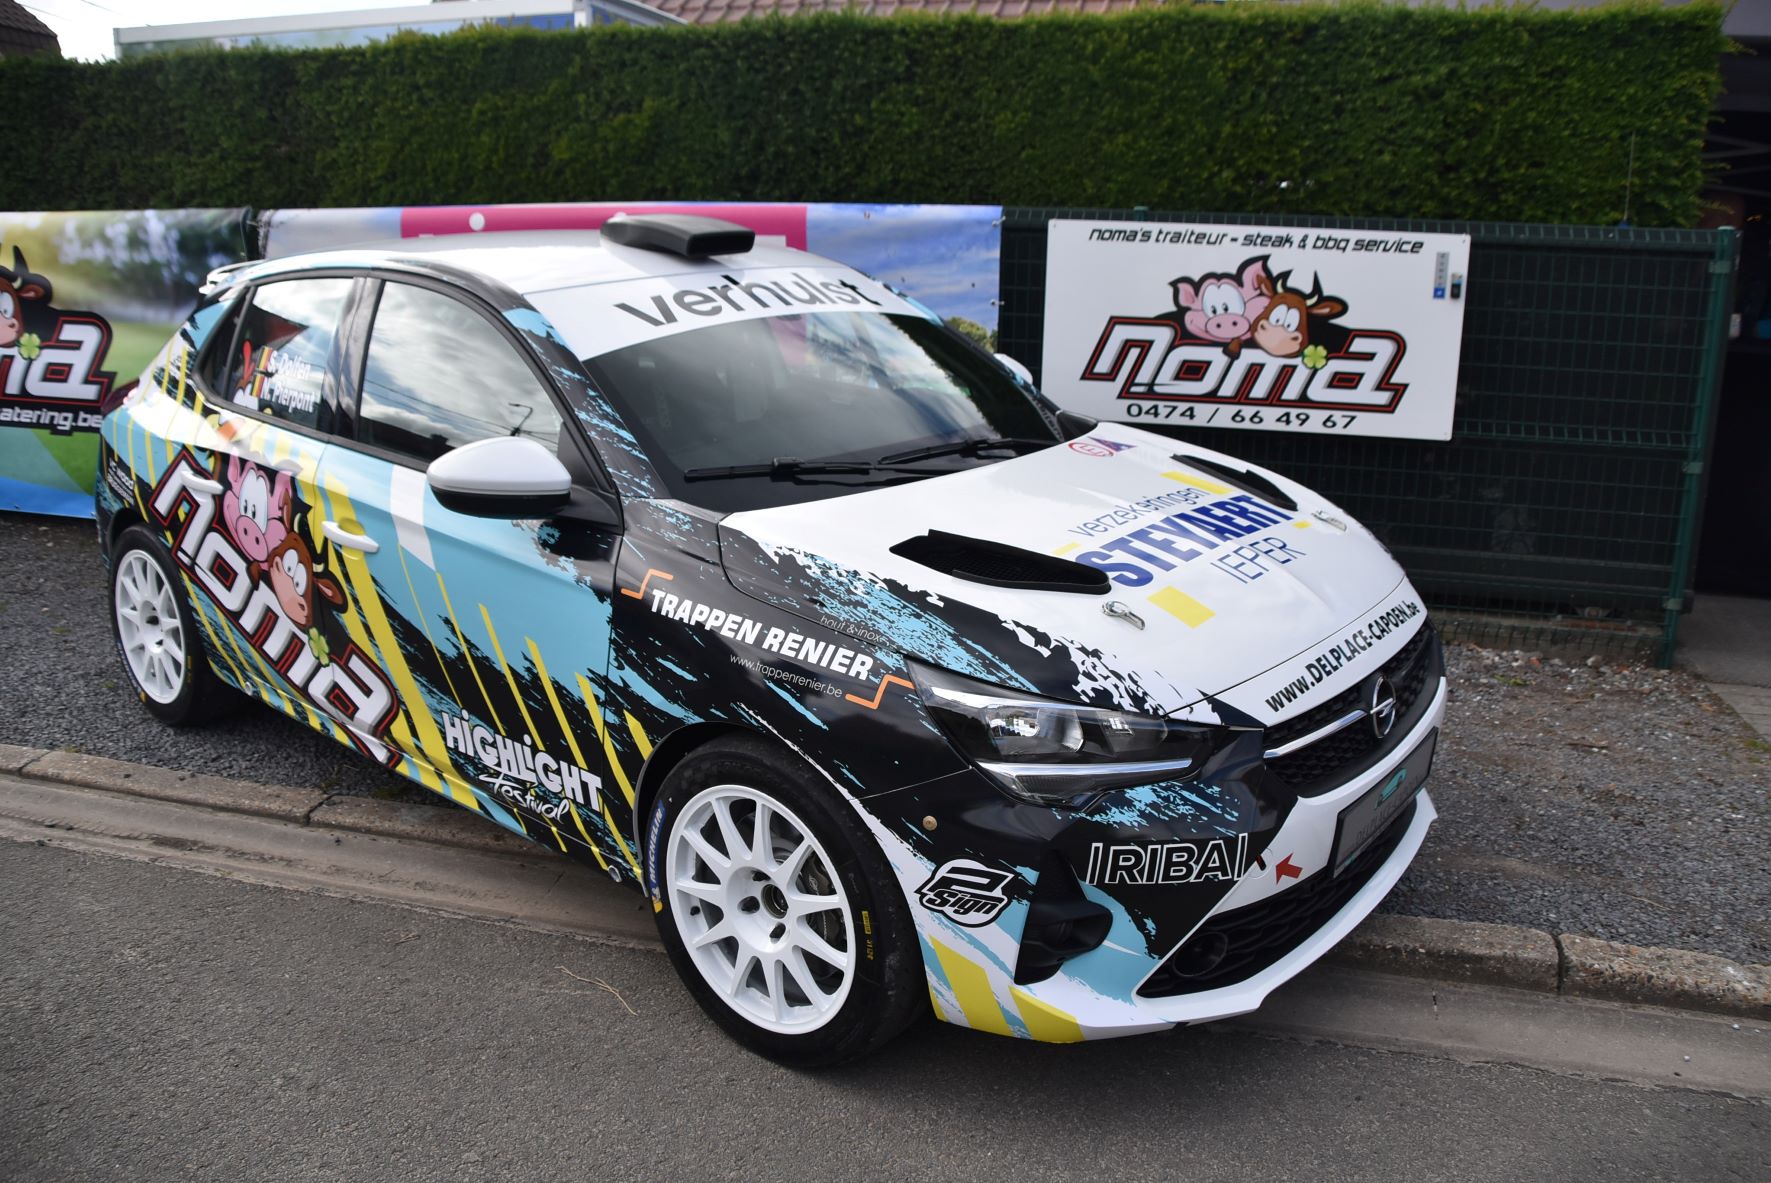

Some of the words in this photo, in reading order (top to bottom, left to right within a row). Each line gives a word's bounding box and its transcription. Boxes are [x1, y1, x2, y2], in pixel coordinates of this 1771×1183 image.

[1088, 227, 1151, 243] noma's
[1154, 228, 1229, 246] traiteur
[1241, 231, 1294, 249] steak
[1299, 234, 1309, 250] &
[1312, 233, 1350, 254] bbq
[1352, 236, 1425, 255] service
[615, 273, 883, 328] verhulst
[0, 406, 103, 430] atering.be
[1126, 402, 1197, 421] 0474
[1231, 409, 1265, 425] 66
[1275, 411, 1311, 427] 49
[1321, 414, 1358, 430] 67
[1067, 486, 1211, 538] verzekeringen
[1075, 494, 1294, 588] STEYAERT
[1210, 536, 1307, 584] IEPER
[650, 588, 763, 645] TRAPPEN
[761, 626, 874, 681] RENIER
[820, 615, 846, 634] hout
[729, 654, 843, 698] www.trappenrenier.be
[648, 808, 663, 884] MICHELIN
